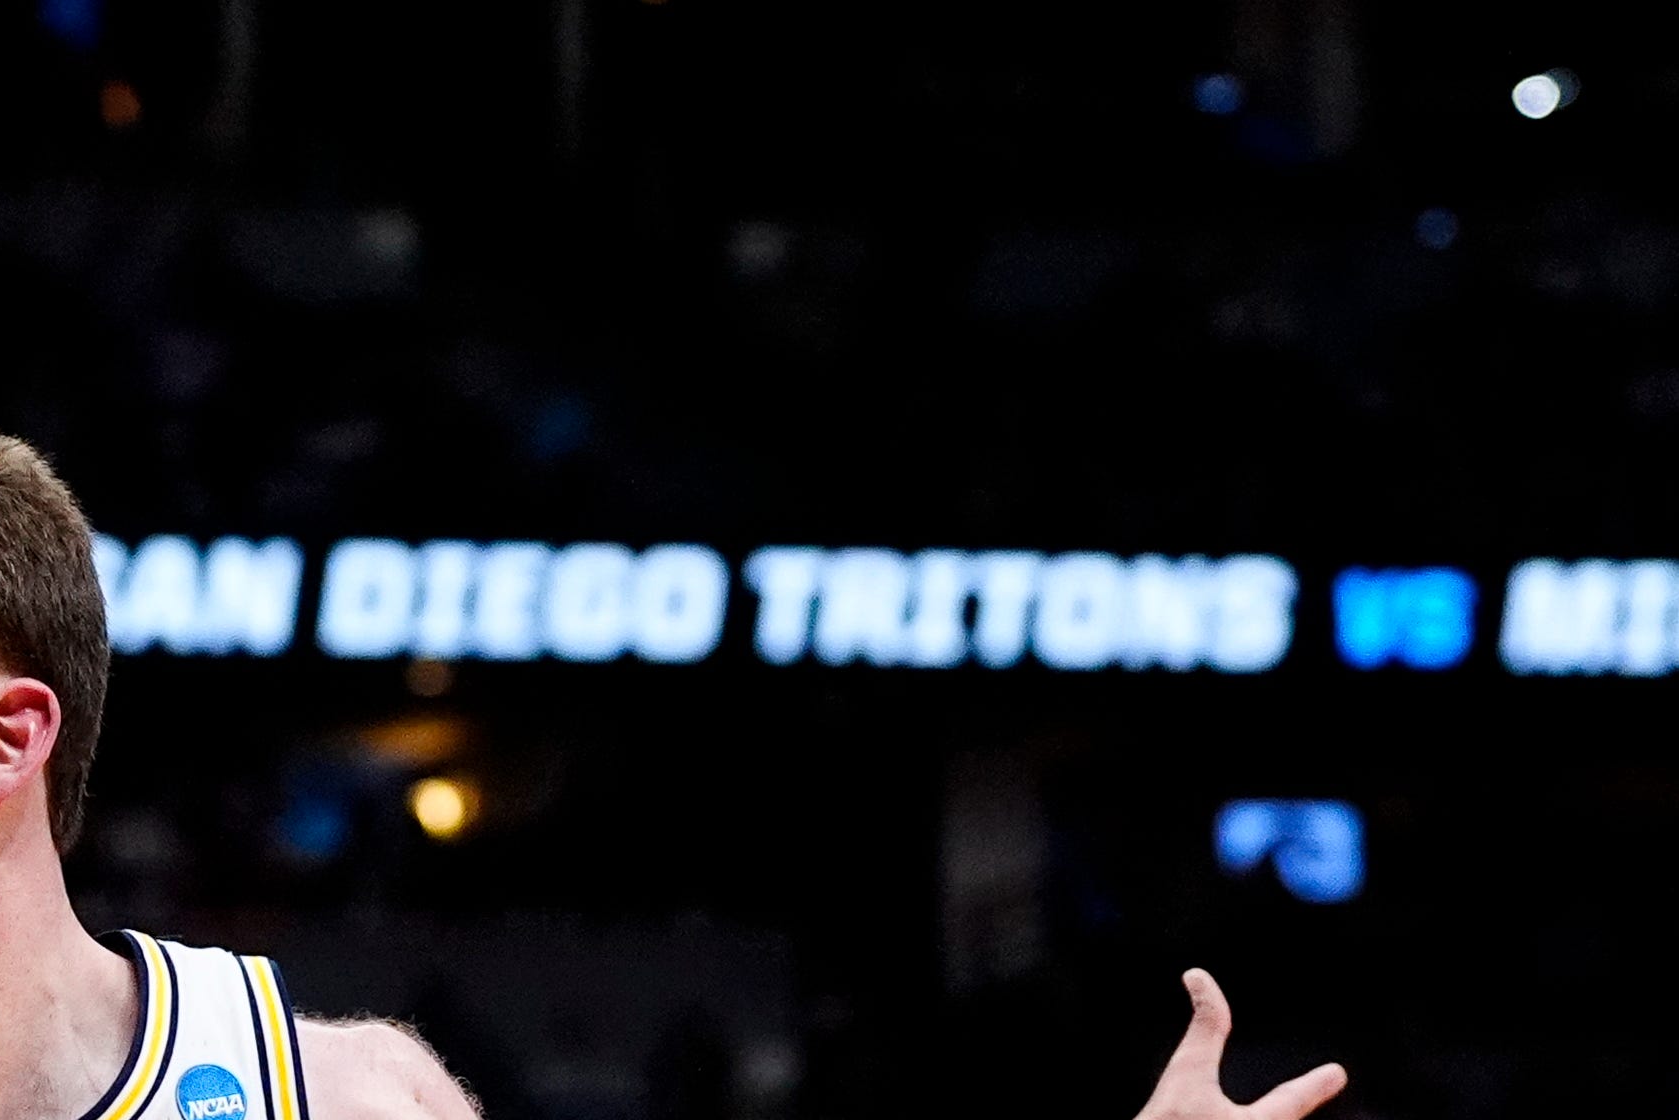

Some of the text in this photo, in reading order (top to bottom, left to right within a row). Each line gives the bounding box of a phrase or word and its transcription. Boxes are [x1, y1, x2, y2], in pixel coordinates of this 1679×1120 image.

[316, 538, 727, 661] DIEGO
[745, 545, 1298, 671] TRITONS
[1333, 565, 1476, 670] VS
[187, 1093, 244, 1120] NCAA
